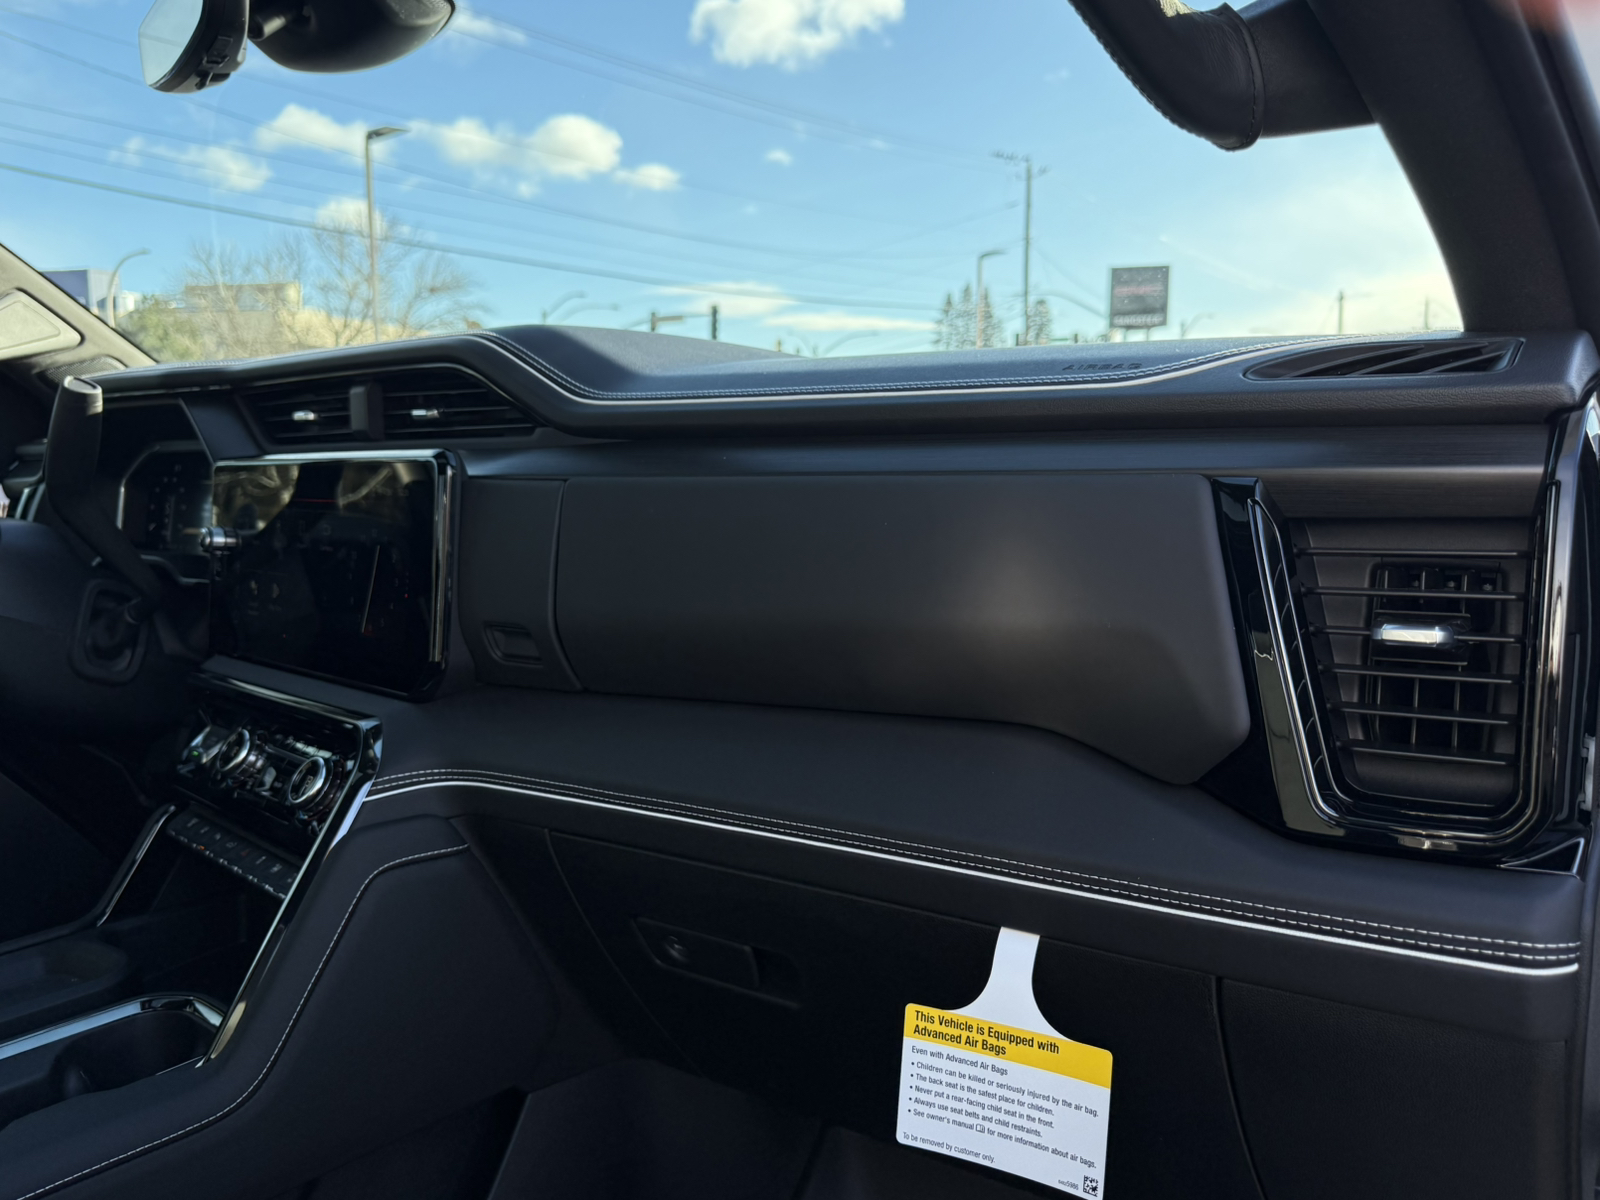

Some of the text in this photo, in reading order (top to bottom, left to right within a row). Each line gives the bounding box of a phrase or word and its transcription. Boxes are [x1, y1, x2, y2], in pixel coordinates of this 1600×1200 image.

[1062, 363, 1142, 371] AIRBAG
[912, 1023, 1006, 1056] Advanced Air Bags
[914, 1009, 1060, 1054] This Vehicle is Equipped with
[911, 1045, 1008, 1076] Even with Advanced Air Bags
[914, 1084, 933, 1095] Never
[933, 1090, 945, 1098] put
[951, 1094, 986, 1110] rear-facing
[986, 1103, 1002, 1113] child
[1003, 1108, 1017, 1118] seat
[1017, 1111, 1025, 1120] in
[1025, 1113, 1036, 1123] the
[1037, 1116, 1054, 1129] front.
[915, 1072, 1054, 1116] The back seat is the safest place for children.
[916, 1061, 943, 1073] Children
[944, 1069, 957, 1077] can
[958, 1070, 967, 1080] be
[967, 1073, 986, 1084] killed
[995, 1081, 1026, 1096] seriously
[1026, 1088, 1050, 1102] injured
[1051, 1095, 1060, 1106] by
[1061, 1098, 1073, 1109] the
[1073, 1103, 1083, 1111] air
[1084, 1105, 1098, 1118] bag.
[913, 1096, 1042, 1138] Always use seat belts and child restraints.
[913, 1108, 1096, 1169] See owner's manual for more information about air bags.
[903, 1131, 995, 1164] To be removed by customer only.
